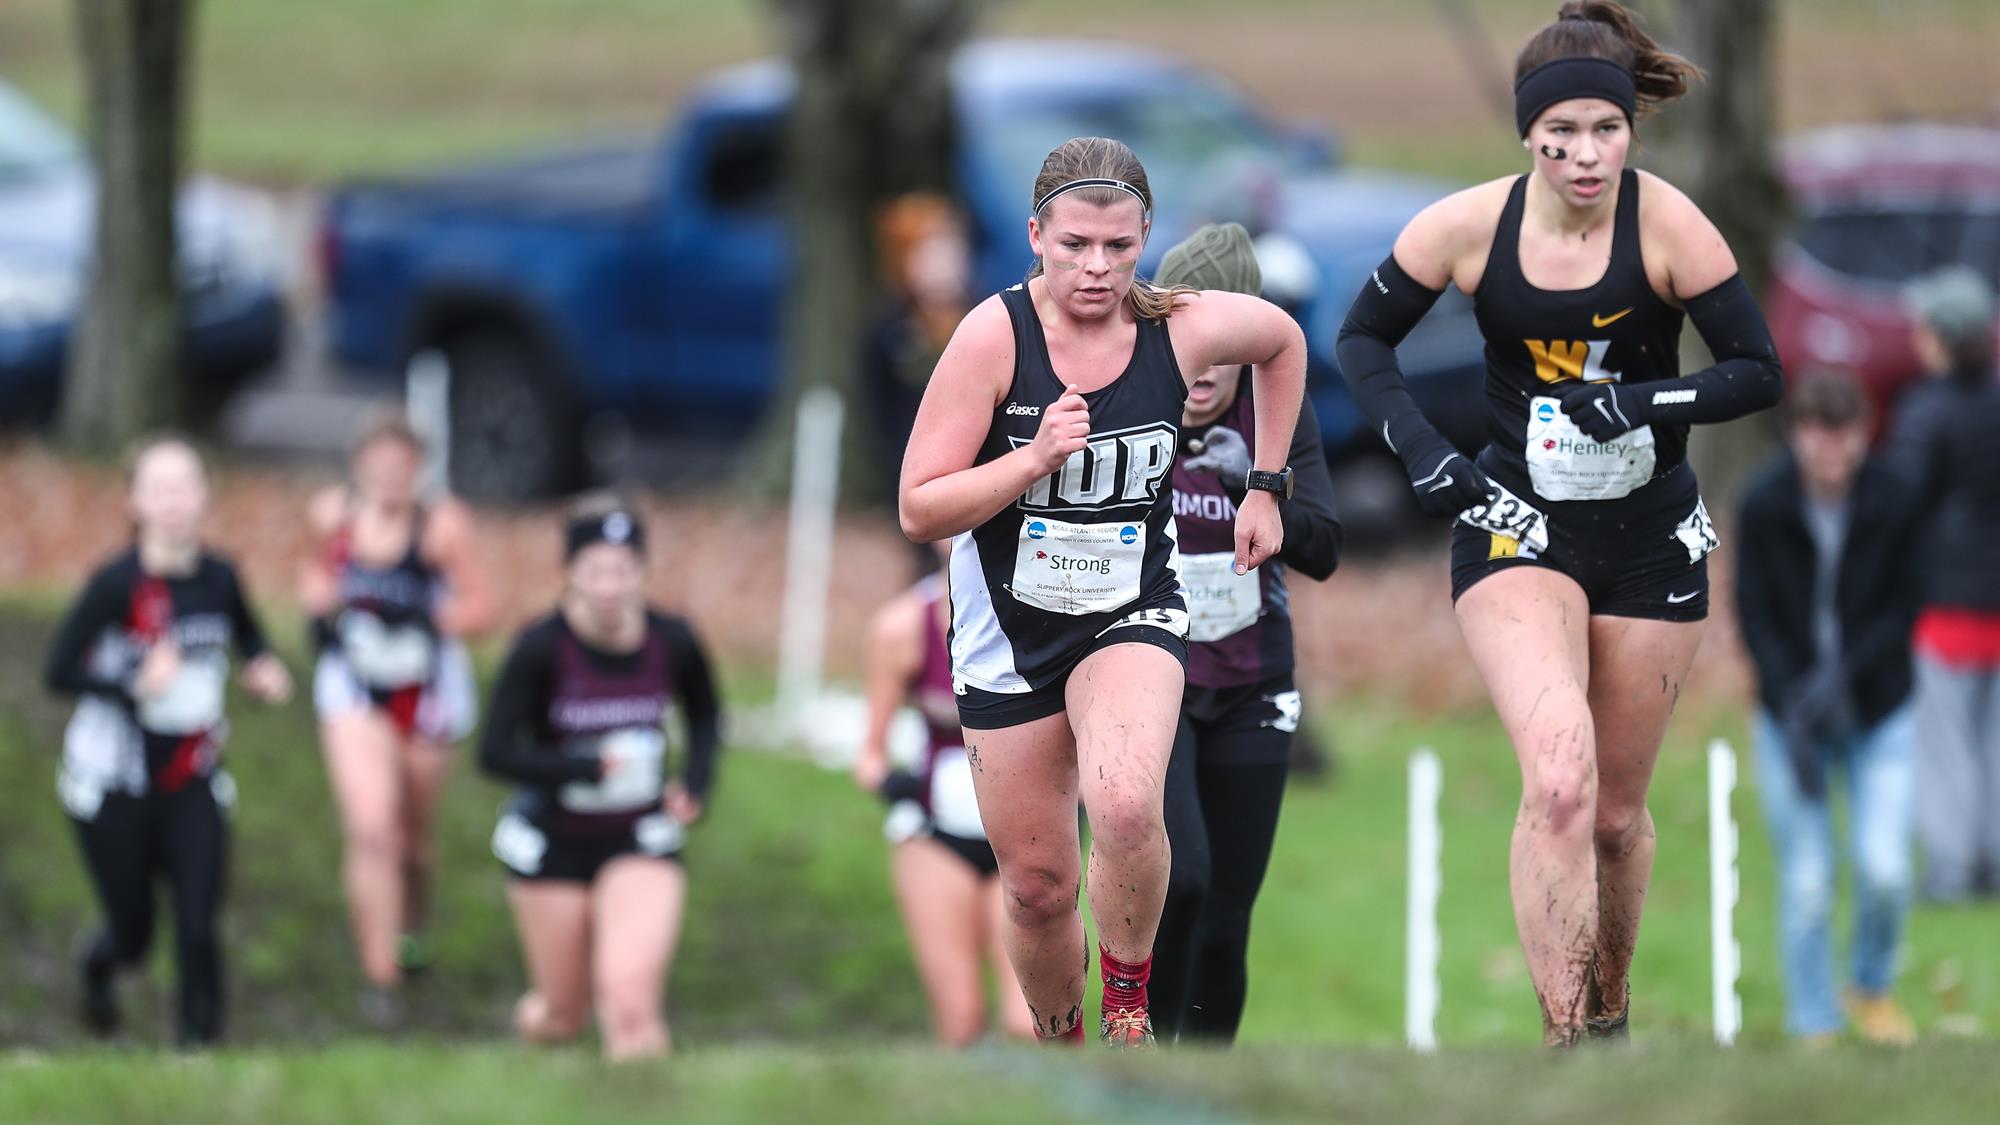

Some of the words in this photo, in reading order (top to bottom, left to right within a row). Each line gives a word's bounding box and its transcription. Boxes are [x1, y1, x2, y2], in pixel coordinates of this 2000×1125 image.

[1523, 339, 1623, 383] WL
[1559, 437, 1629, 458] Henley
[1049, 554, 1112, 575] Strong
[1036, 583, 1064, 592] SLIPPERY
[1064, 586, 1081, 594] ROCK
